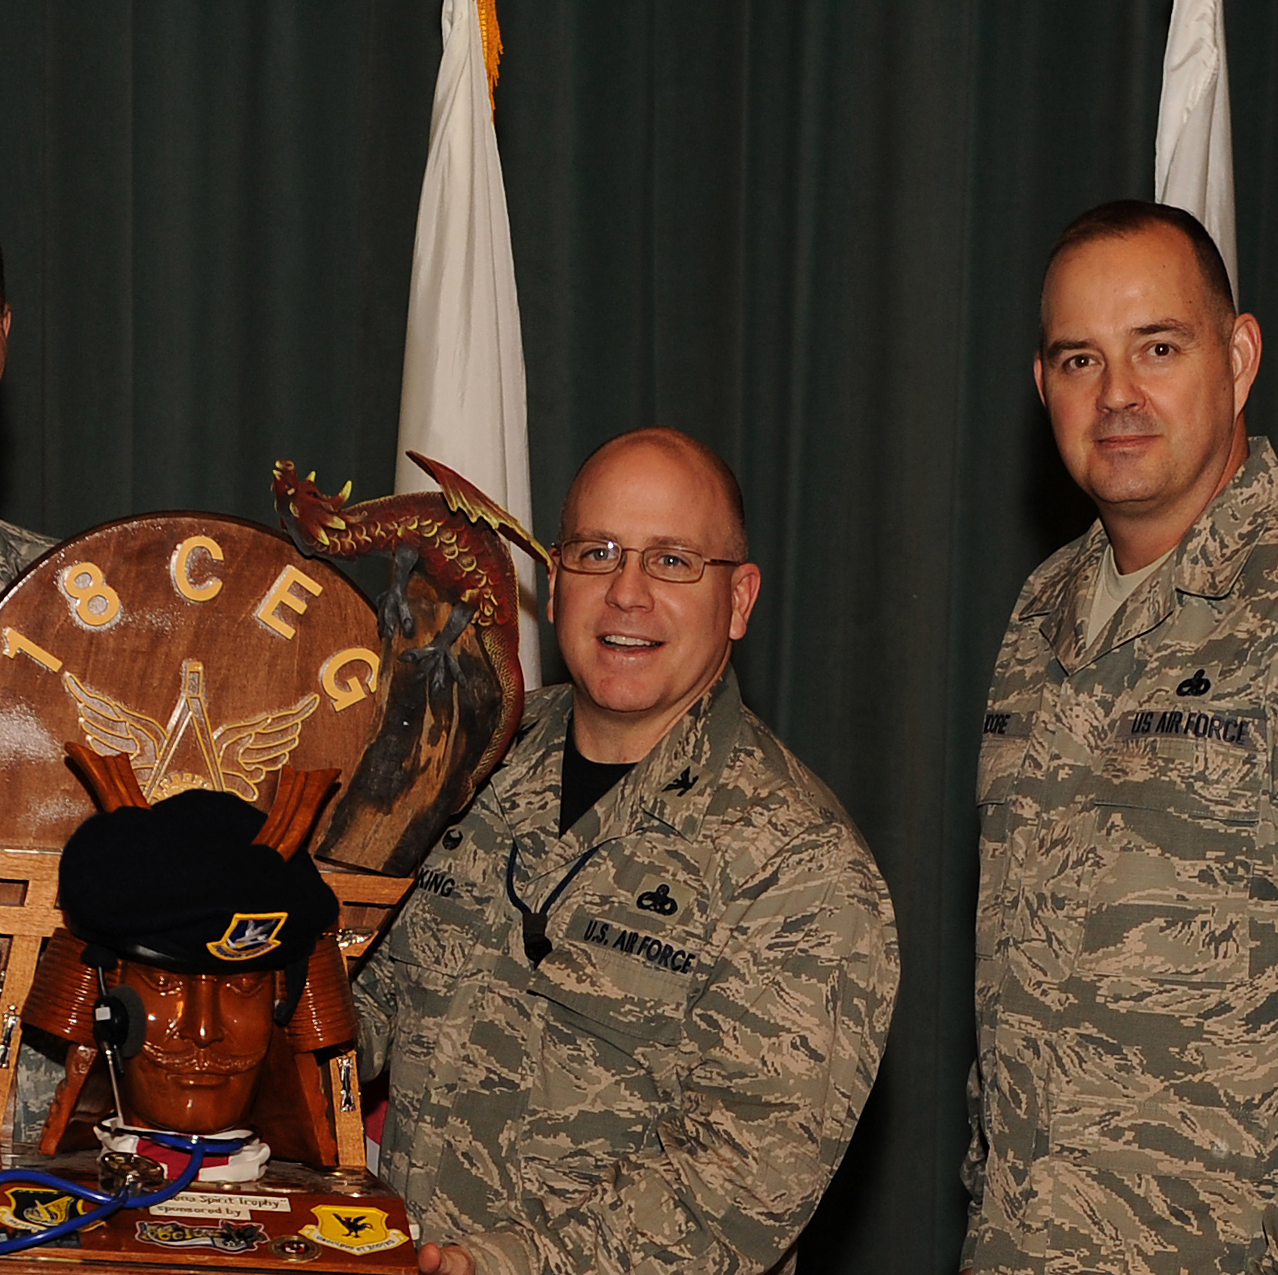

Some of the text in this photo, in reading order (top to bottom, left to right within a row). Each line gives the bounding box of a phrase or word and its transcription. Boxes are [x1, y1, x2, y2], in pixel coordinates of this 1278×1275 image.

[2, 535, 381, 713] 18 CEG
[1155, 711, 1183, 734] AIR
[1184, 711, 1248, 745] FORCE
[584, 920, 696, 974] U.S. AIR FORCE
[156, 1205, 241, 1218] sponsored by
[199, 1194, 234, 1205] Spirit
